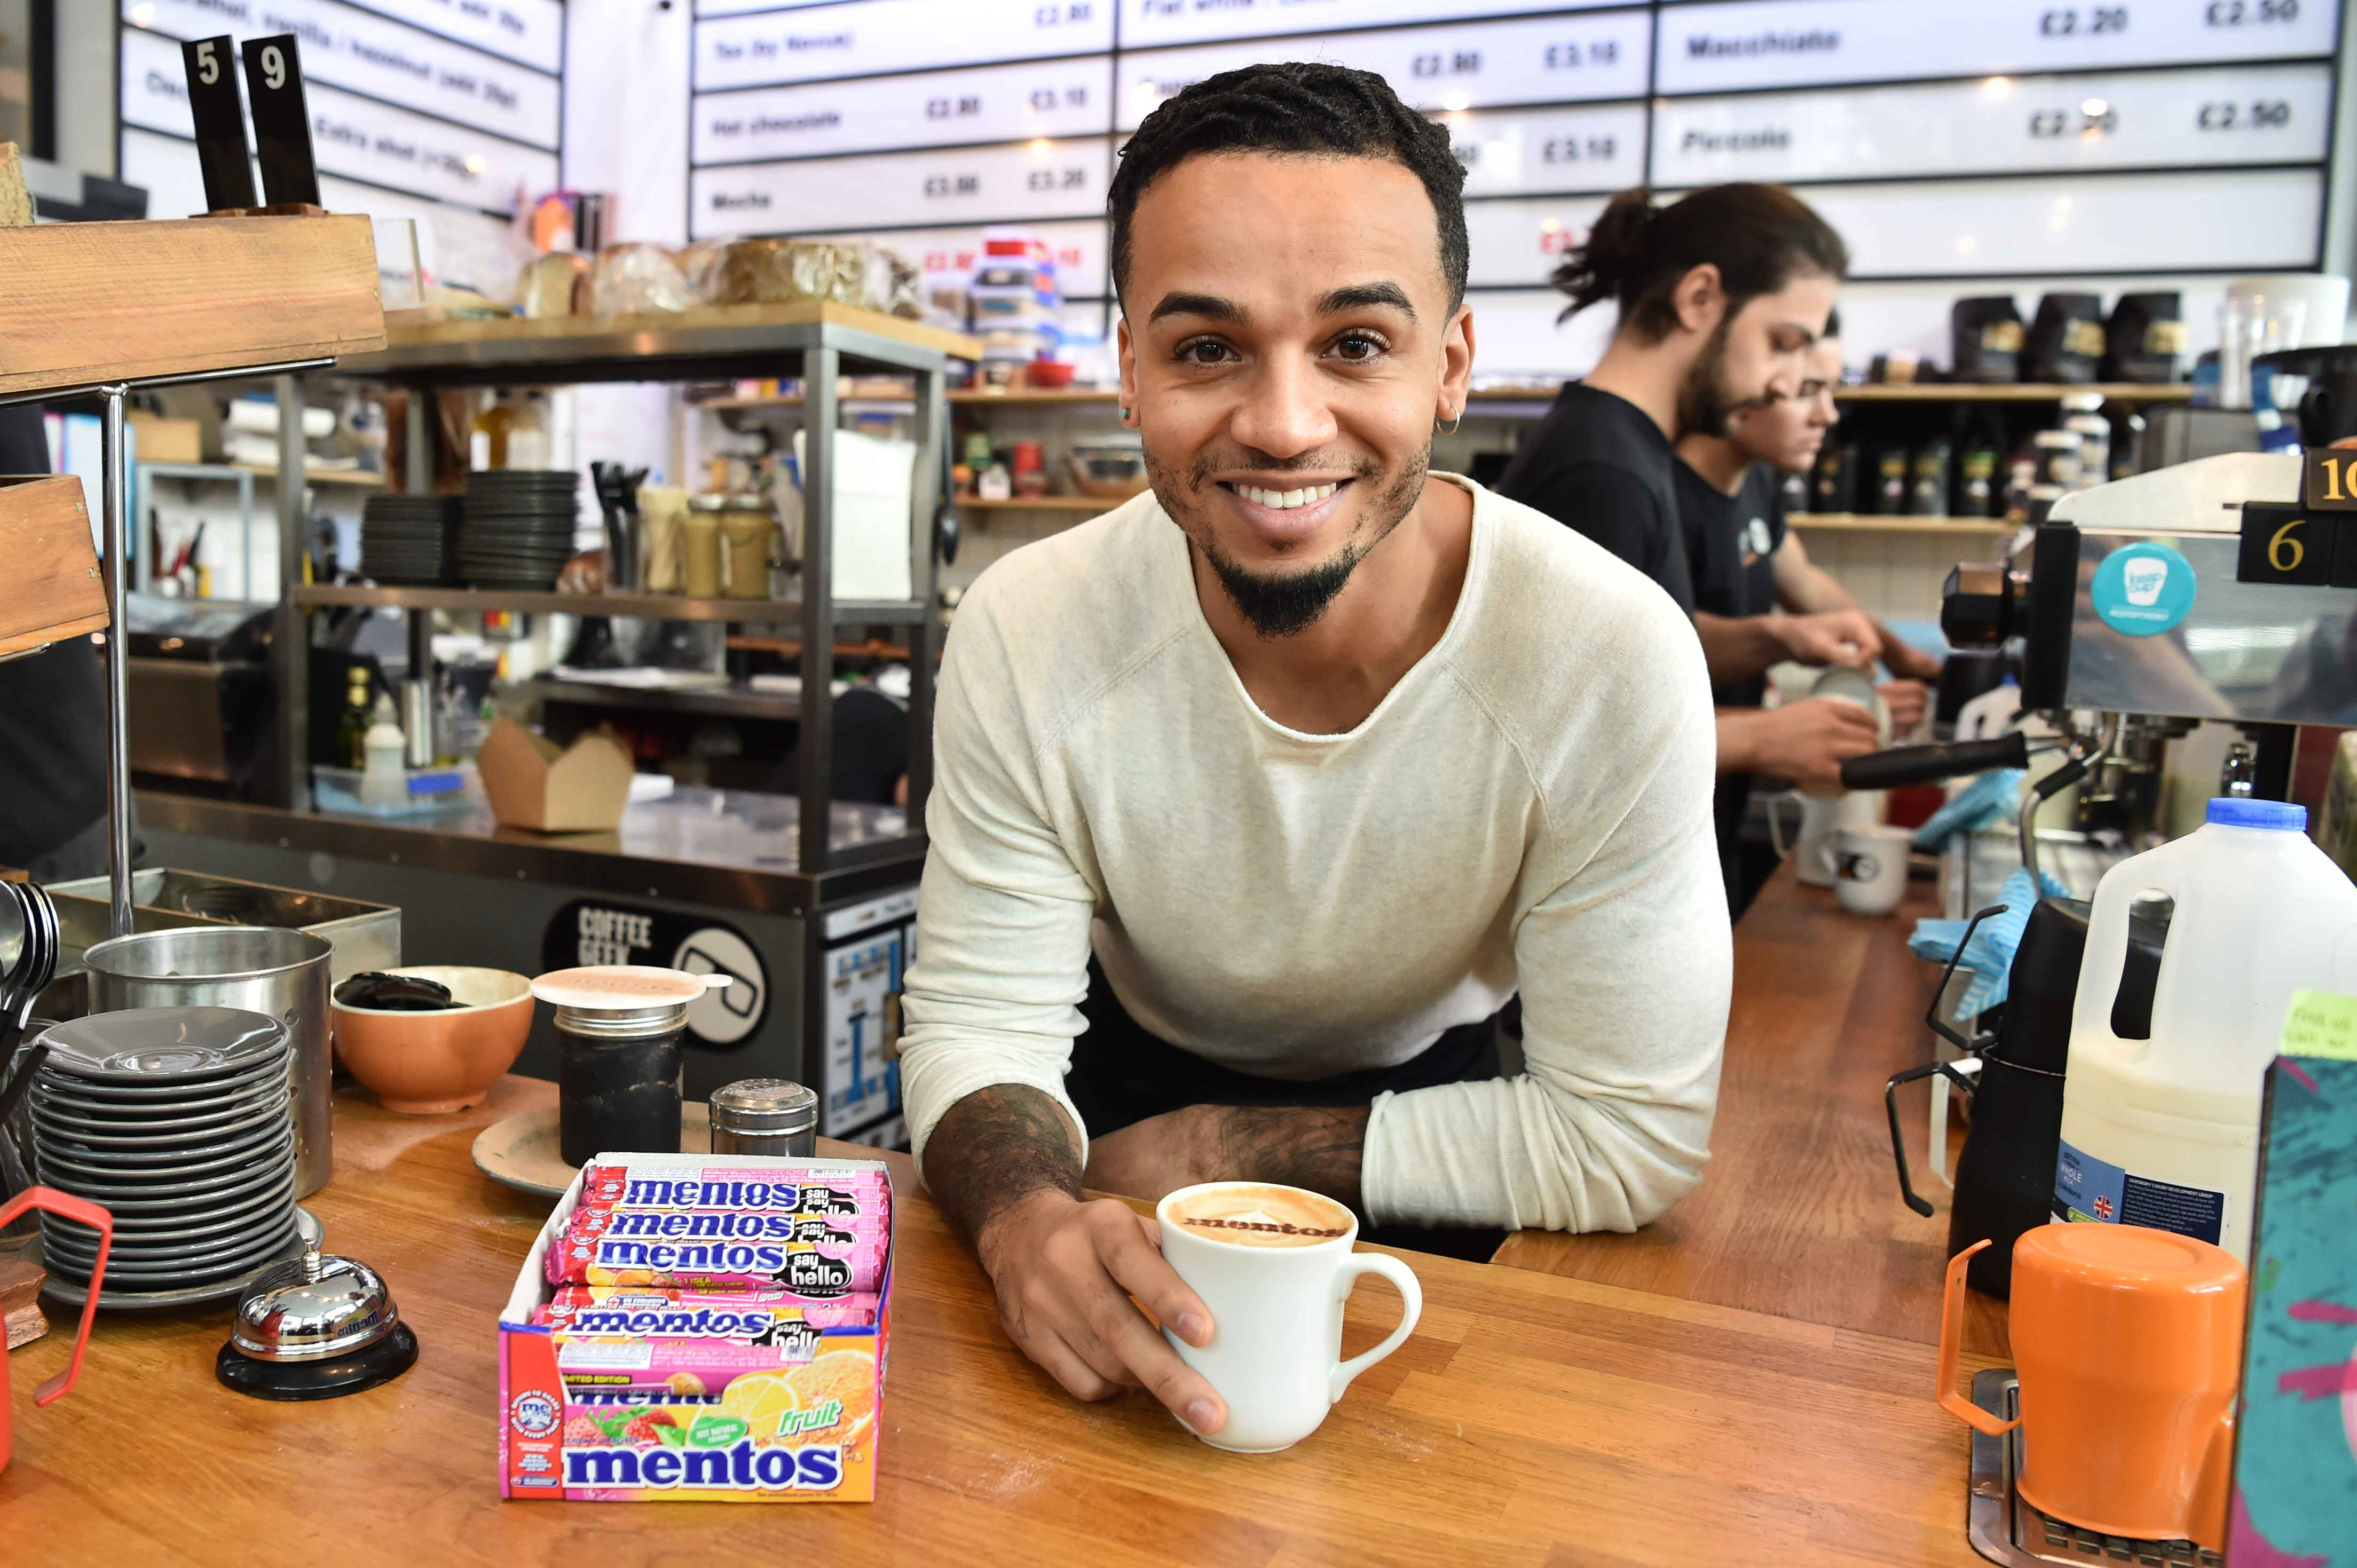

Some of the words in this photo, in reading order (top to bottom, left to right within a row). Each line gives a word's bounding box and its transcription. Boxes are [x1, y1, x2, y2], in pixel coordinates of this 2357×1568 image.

[1687, 30, 1839, 58] Macchiato
[2040, 7, 2127, 36] £2.20
[2206, 0, 2299, 26] £2.50
[196, 41, 219, 85] 5
[261, 45, 286, 90] 9
[1545, 42, 1622, 68] £3.10
[713, 118, 744, 136] Hot
[750, 111, 841, 134] chocolate
[1682, 127, 1792, 155] Piccolo
[2197, 100, 2291, 130] £2.50
[1542, 138, 1618, 164] £3.10
[713, 191, 772, 210] Mocha
[2267, 519, 2307, 572] 6
[579, 906, 652, 949] COFFEE
[2061, 1162, 2082, 1183] WHOLE
[624, 1180, 798, 1207] mentos
[2168, 1187, 2198, 1196] DEVELOPMENT
[610, 1212, 793, 1238] mentos
[598, 1242, 784, 1270] mentos
[793, 1255, 819, 1270] say
[690, 1276, 711, 1285] IDEA
[791, 1265, 844, 1286] hello
[570, 1309, 771, 1333] mentos
[594, 1375, 630, 1384] EDITION
[779, 1399, 842, 1436] fruit
[566, 1438, 839, 1485] mentos
